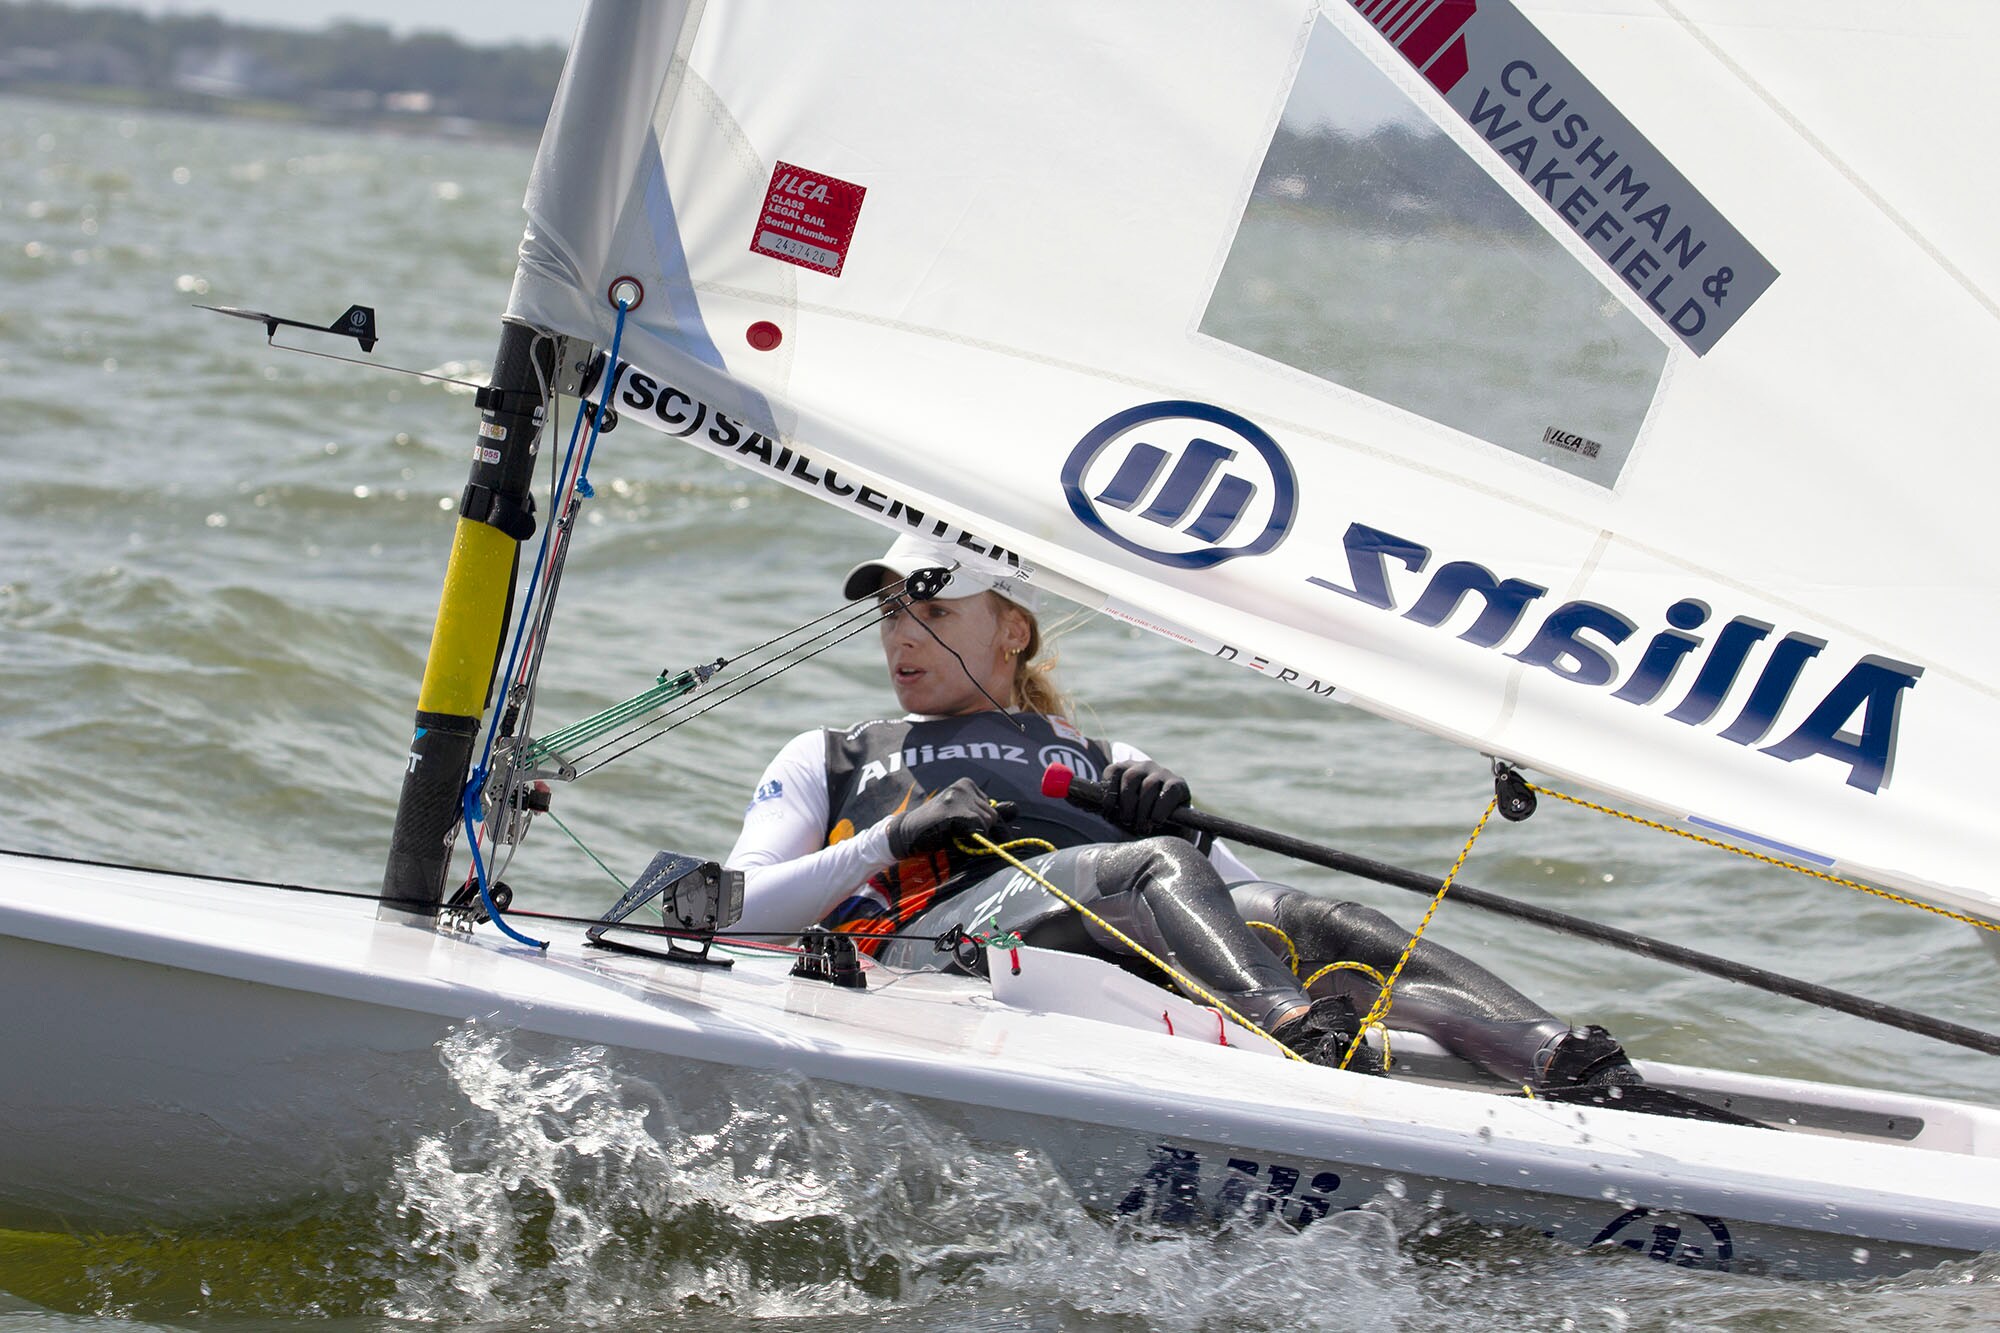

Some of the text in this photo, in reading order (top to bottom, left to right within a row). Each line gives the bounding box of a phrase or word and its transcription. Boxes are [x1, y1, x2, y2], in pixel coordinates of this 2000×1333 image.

[777, 174, 829, 205] ILCA
[1500, 60, 1735, 308] CUSHMAN &
[768, 203, 826, 228] LEGAL SAIL
[771, 193, 805, 210] CLASS
[1468, 86, 1707, 337] WAKEFIELD
[764, 215, 838, 245] Serial Number:
[775, 238, 826, 263] 2437426
[1551, 430, 1583, 449] ILCA
[857, 741, 1029, 797] Allianz
